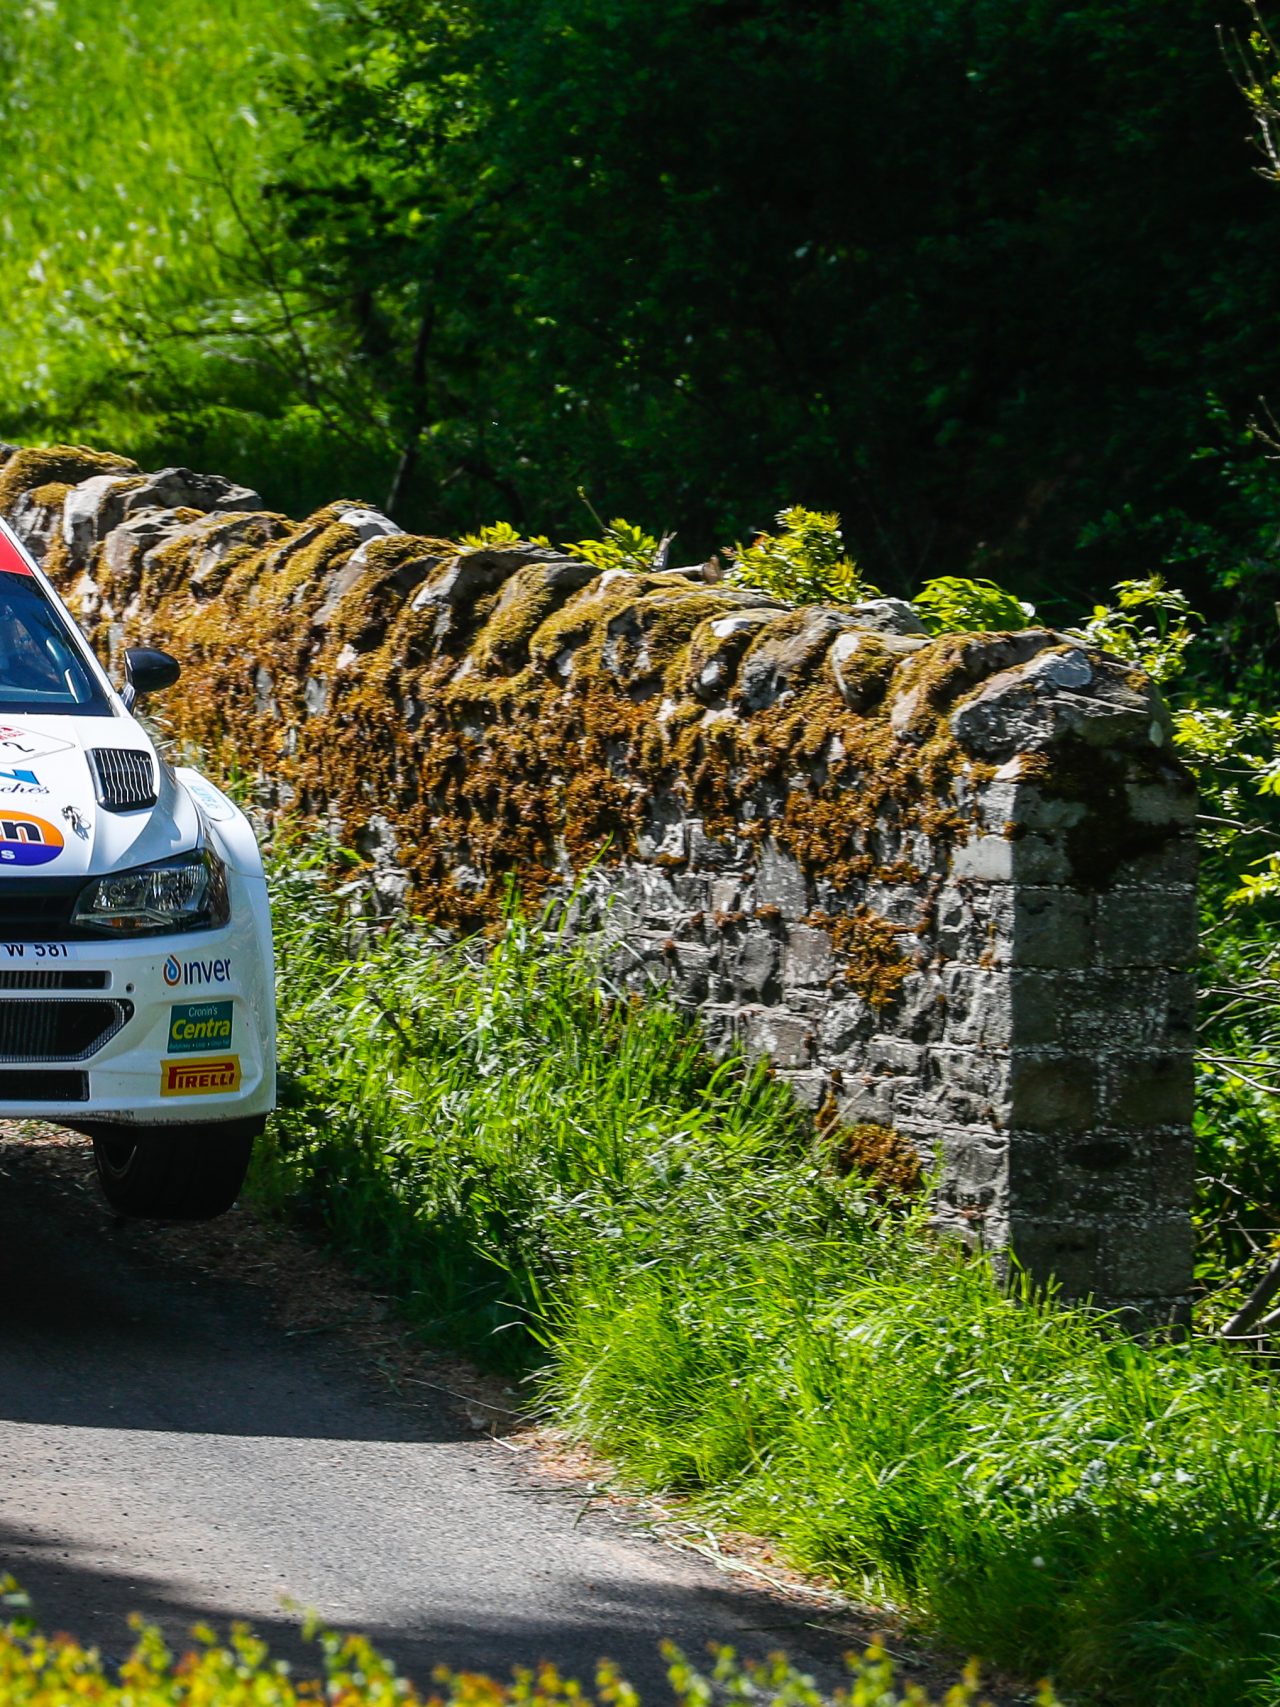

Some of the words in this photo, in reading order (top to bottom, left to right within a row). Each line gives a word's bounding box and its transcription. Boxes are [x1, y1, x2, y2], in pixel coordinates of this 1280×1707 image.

[1, 741, 35, 753] 2
[183, 957, 231, 986] inver
[188, 1005, 218, 1018] Cronin's
[171, 1017, 231, 1041] Centra
[167, 1062, 235, 1090] PIRELLI
